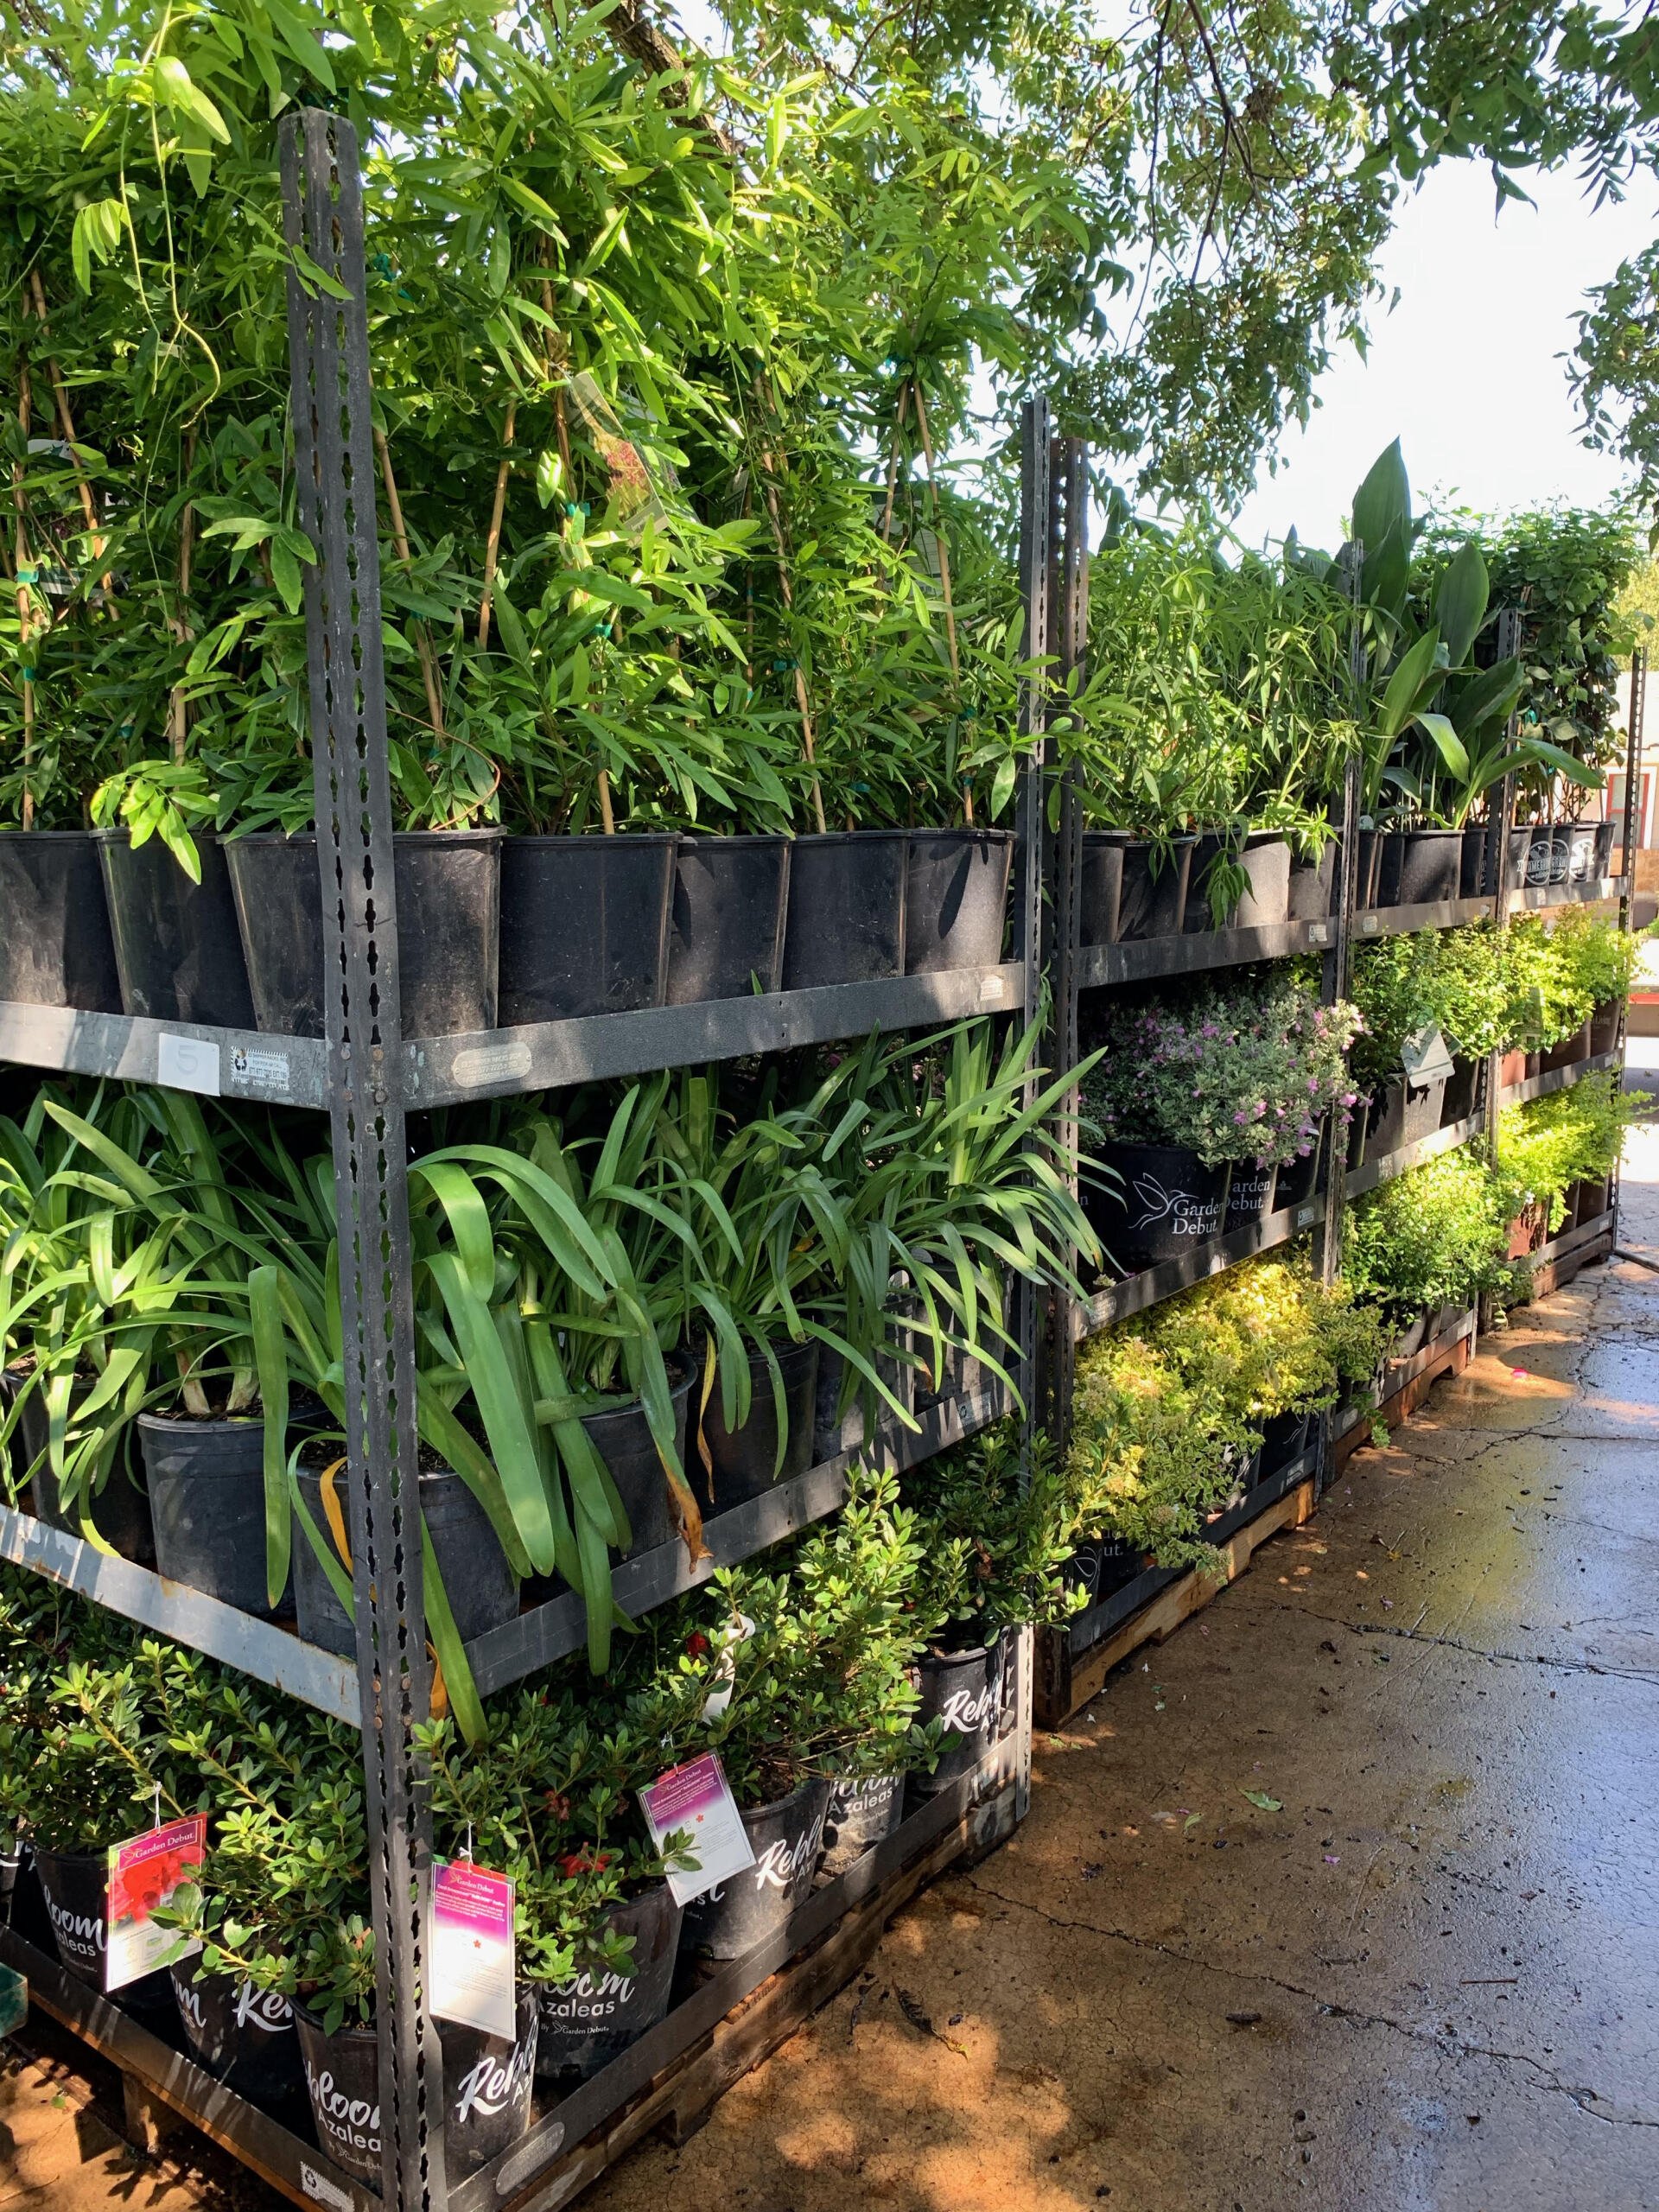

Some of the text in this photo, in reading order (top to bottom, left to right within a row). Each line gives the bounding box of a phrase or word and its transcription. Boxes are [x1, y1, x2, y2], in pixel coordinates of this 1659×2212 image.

[1232, 1175, 1270, 1192] arden
[1172, 1217, 1217, 1235] Debut
[827, 1786, 893, 1814] Azaleas
[135, 1842, 166, 1859] Garden
[44, 1885, 108, 1952] loom
[563, 2025, 586, 2035] Garden
[318, 2106, 382, 2152] Azalea
